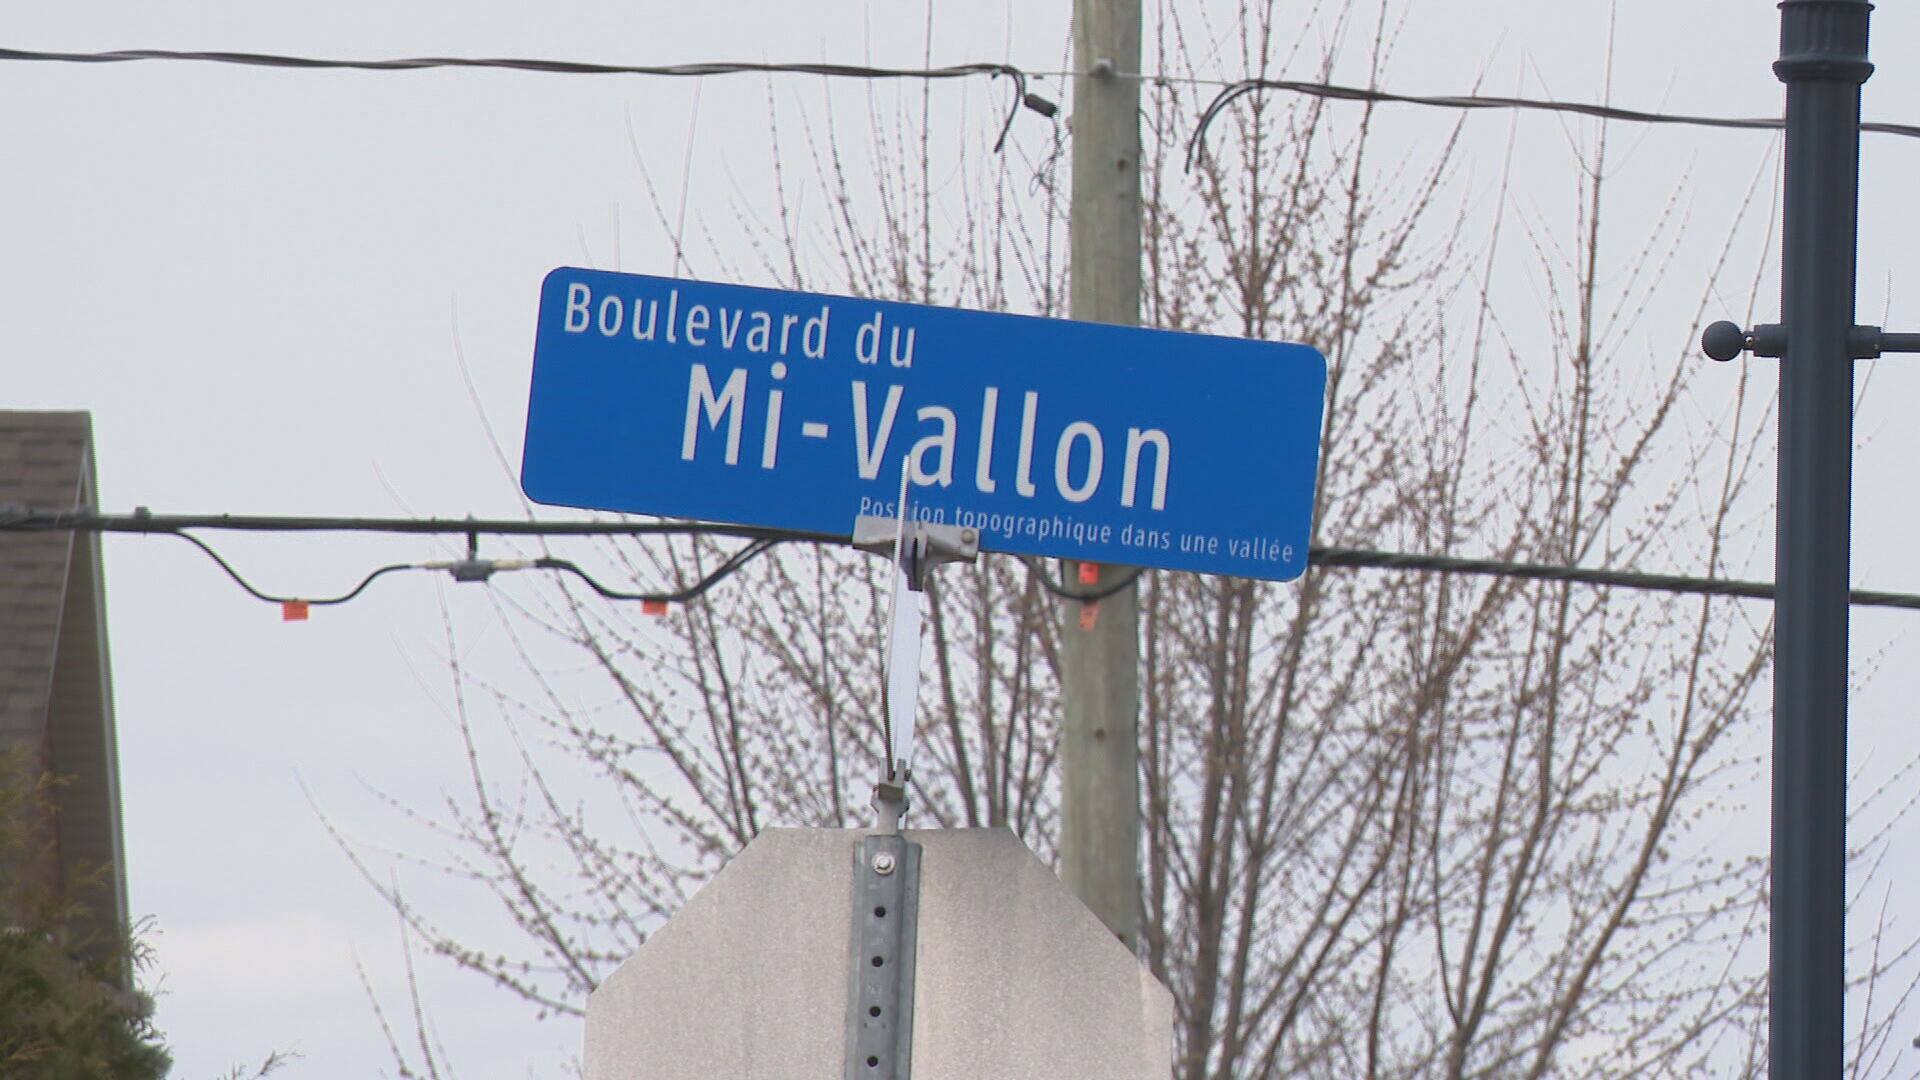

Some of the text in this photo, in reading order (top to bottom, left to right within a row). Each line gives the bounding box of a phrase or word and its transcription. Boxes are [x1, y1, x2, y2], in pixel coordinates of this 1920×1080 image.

[564, 282, 916, 368] Boulevard du
[681, 362, 1171, 511] Mi-Vallon
[860, 496, 1293, 562] Posion topographique dans une vallée
